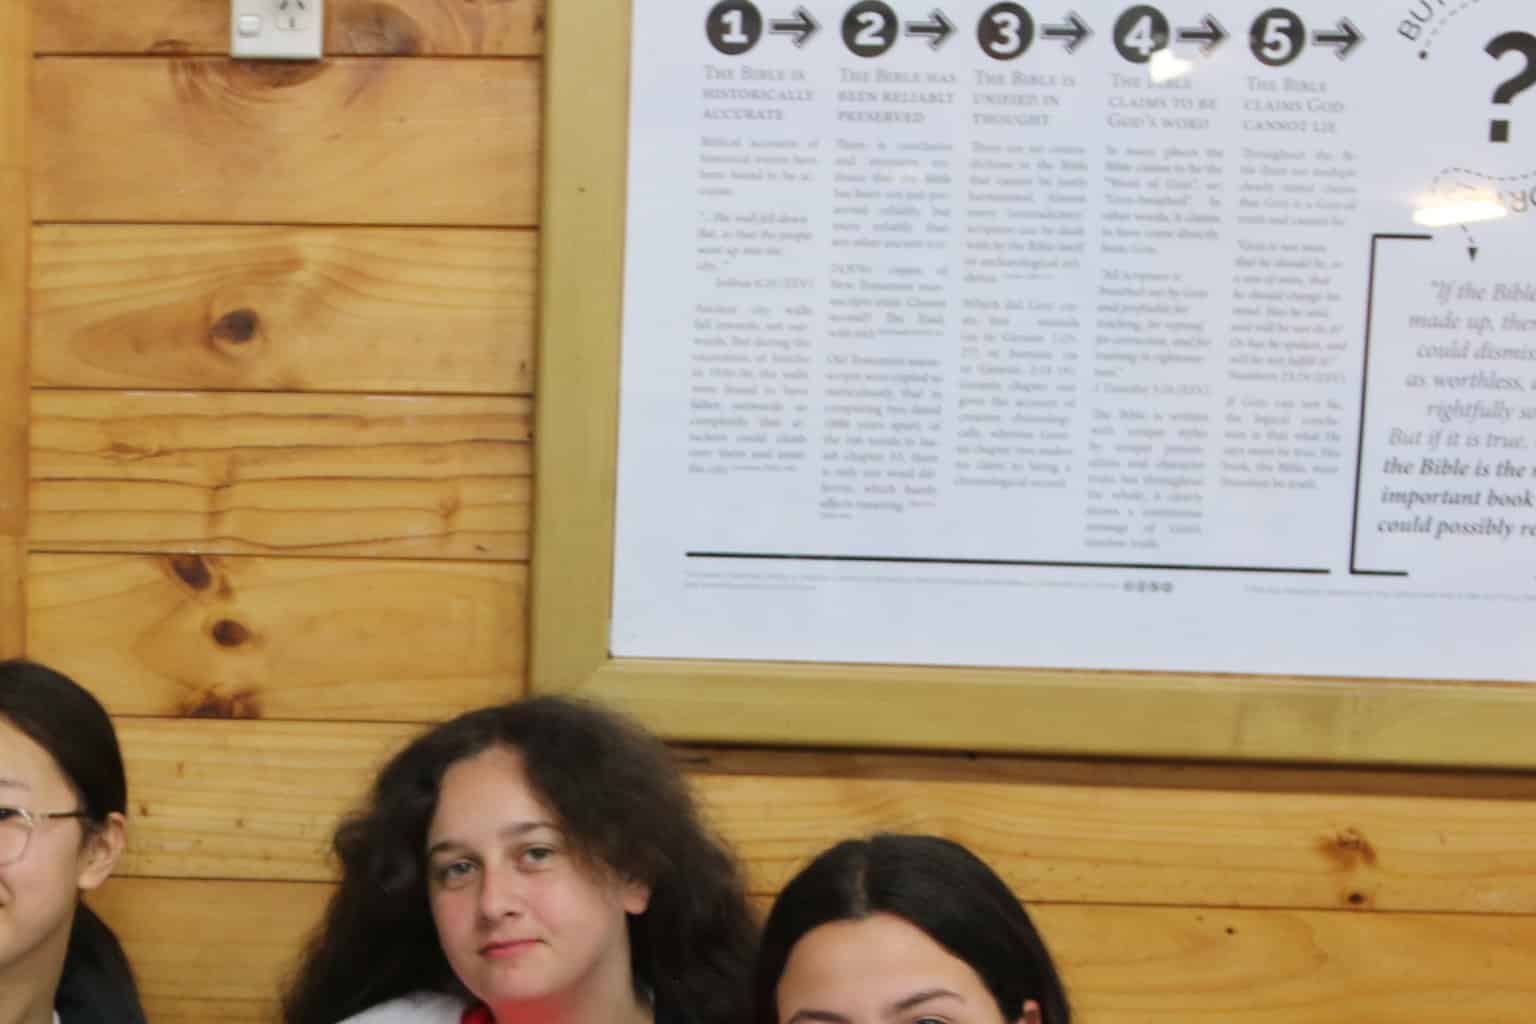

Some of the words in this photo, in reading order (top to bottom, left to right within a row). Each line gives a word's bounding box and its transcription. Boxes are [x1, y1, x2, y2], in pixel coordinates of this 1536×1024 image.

[1389, 427, 1424, 447] But
[1382, 456, 1414, 475] the
[1420, 457, 1471, 477] Bible
[1474, 458, 1490, 478] is
[1496, 459, 1528, 479] the
[1381, 485, 1482, 511] important
[1487, 488, 1534, 507] book
[1377, 515, 1433, 534] could
[1434, 517, 1515, 543] possibly
